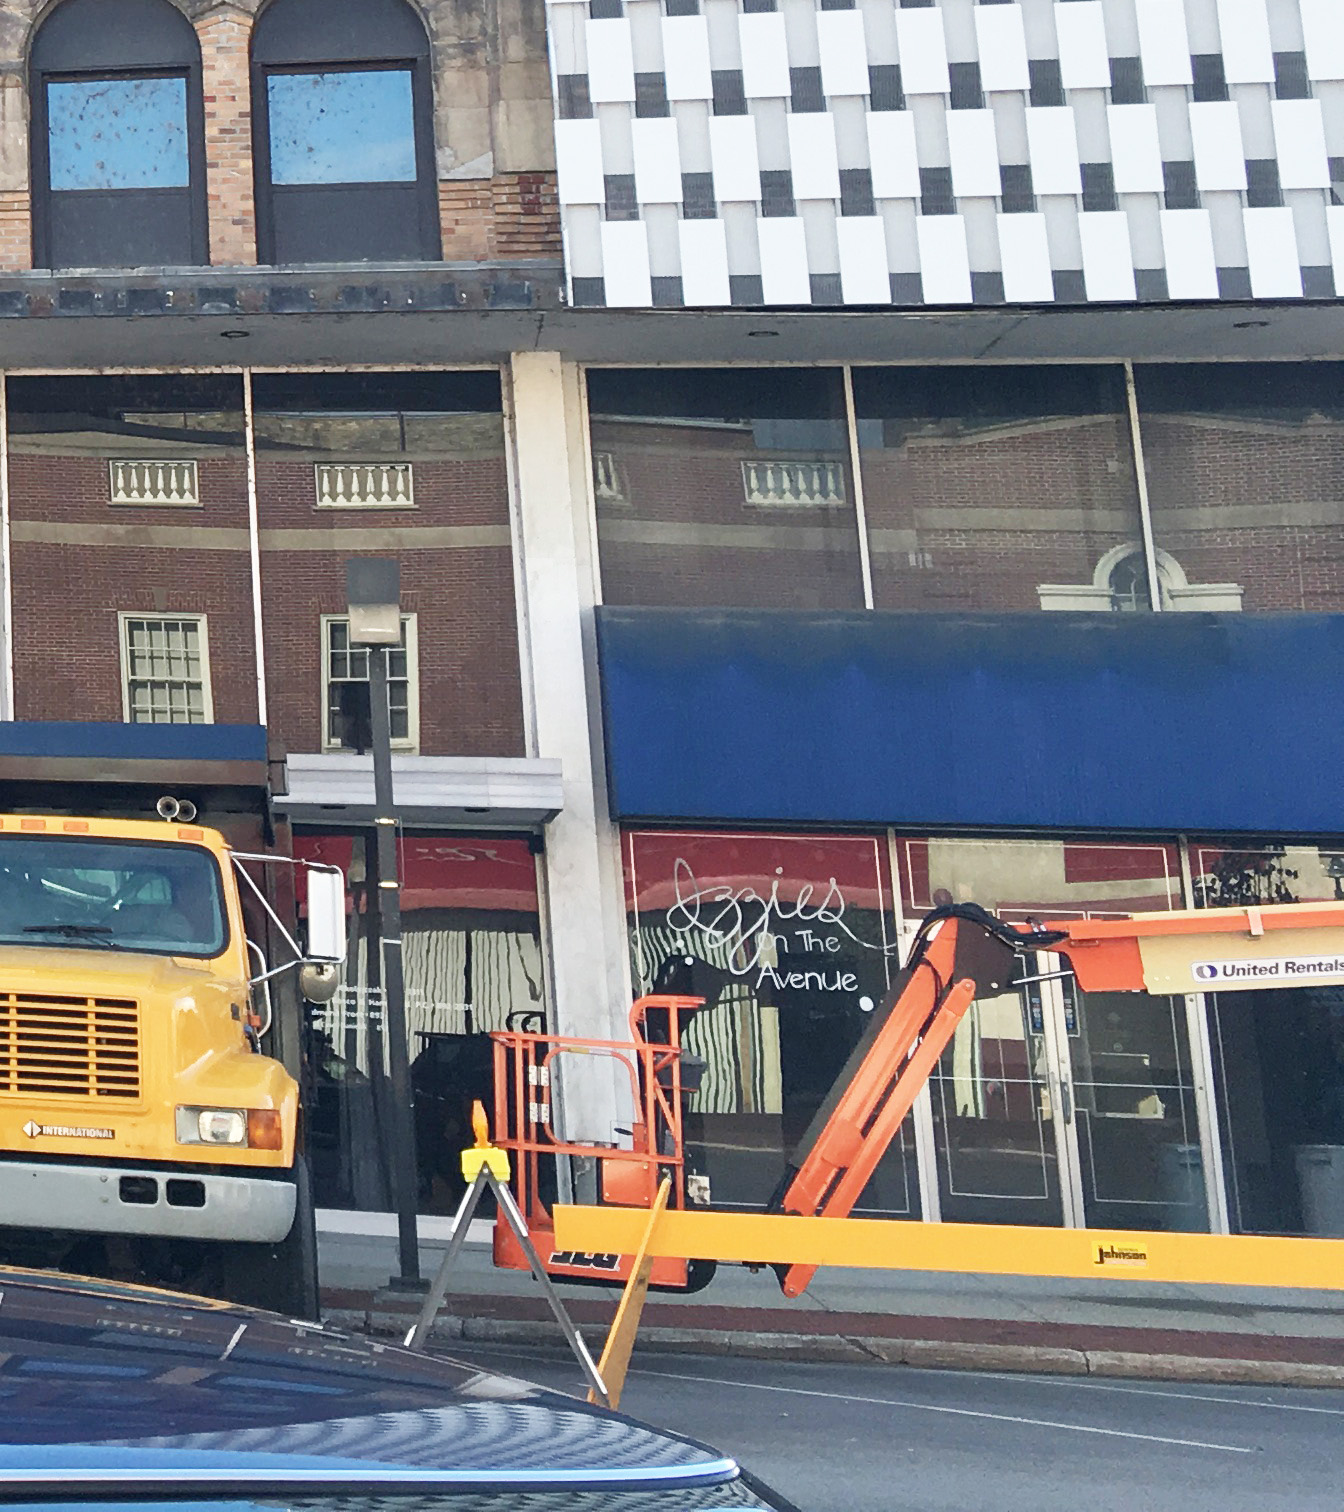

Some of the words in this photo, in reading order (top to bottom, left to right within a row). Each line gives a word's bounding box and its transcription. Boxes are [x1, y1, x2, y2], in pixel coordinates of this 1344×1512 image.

[795, 929, 841, 953] The
[755, 961, 858, 992] Avenue
[1222, 962, 1279, 977] United
[1284, 959, 1344, 974] Rentals
[42, 1125, 113, 1139] INTERNATIONAL
